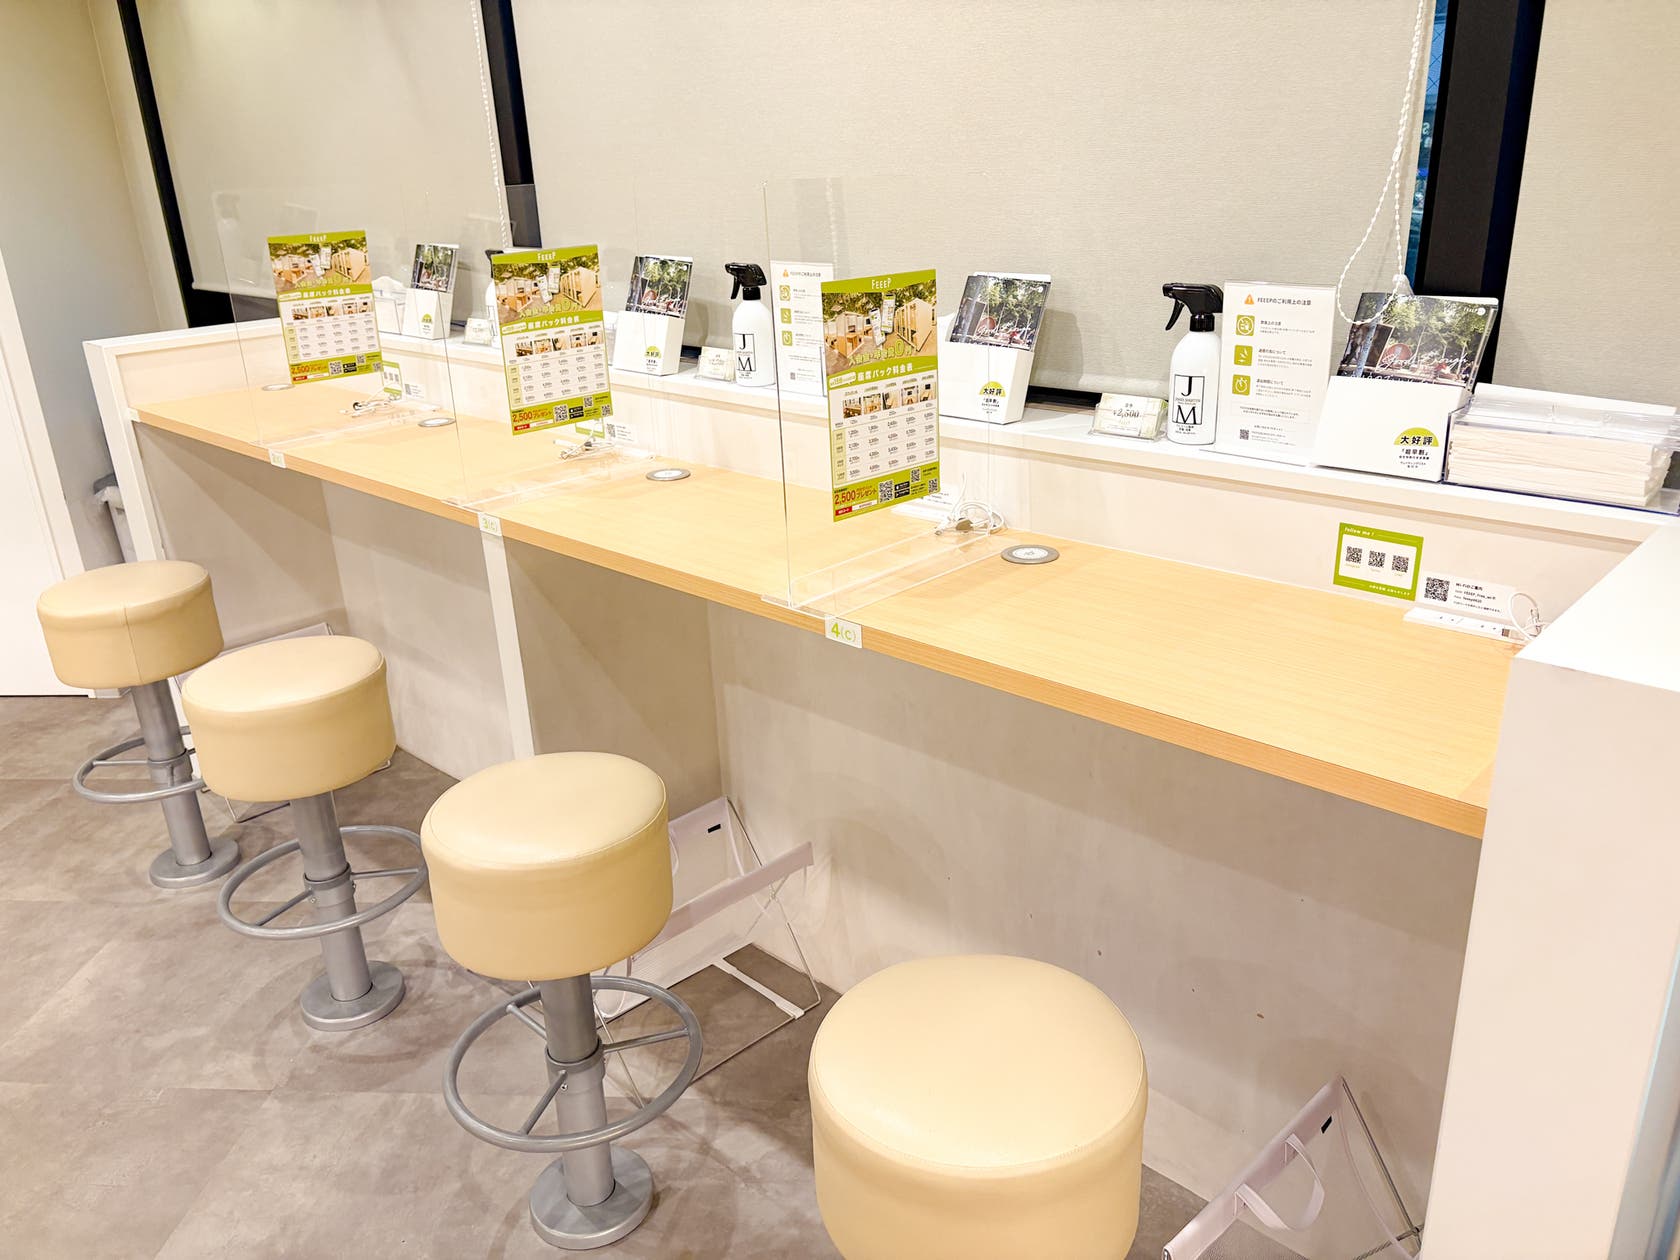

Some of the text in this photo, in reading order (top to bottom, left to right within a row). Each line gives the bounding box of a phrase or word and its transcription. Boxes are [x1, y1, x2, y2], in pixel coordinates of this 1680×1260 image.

[871, 278, 892, 290] FEEEP
[738, 334, 746, 350] J
[738, 356, 753, 371] M
[1181, 376, 1193, 397] J
[1175, 404, 1197, 424] M
[1400, 435, 1433, 446] 大好評
[834, 489, 857, 506] 2,500
